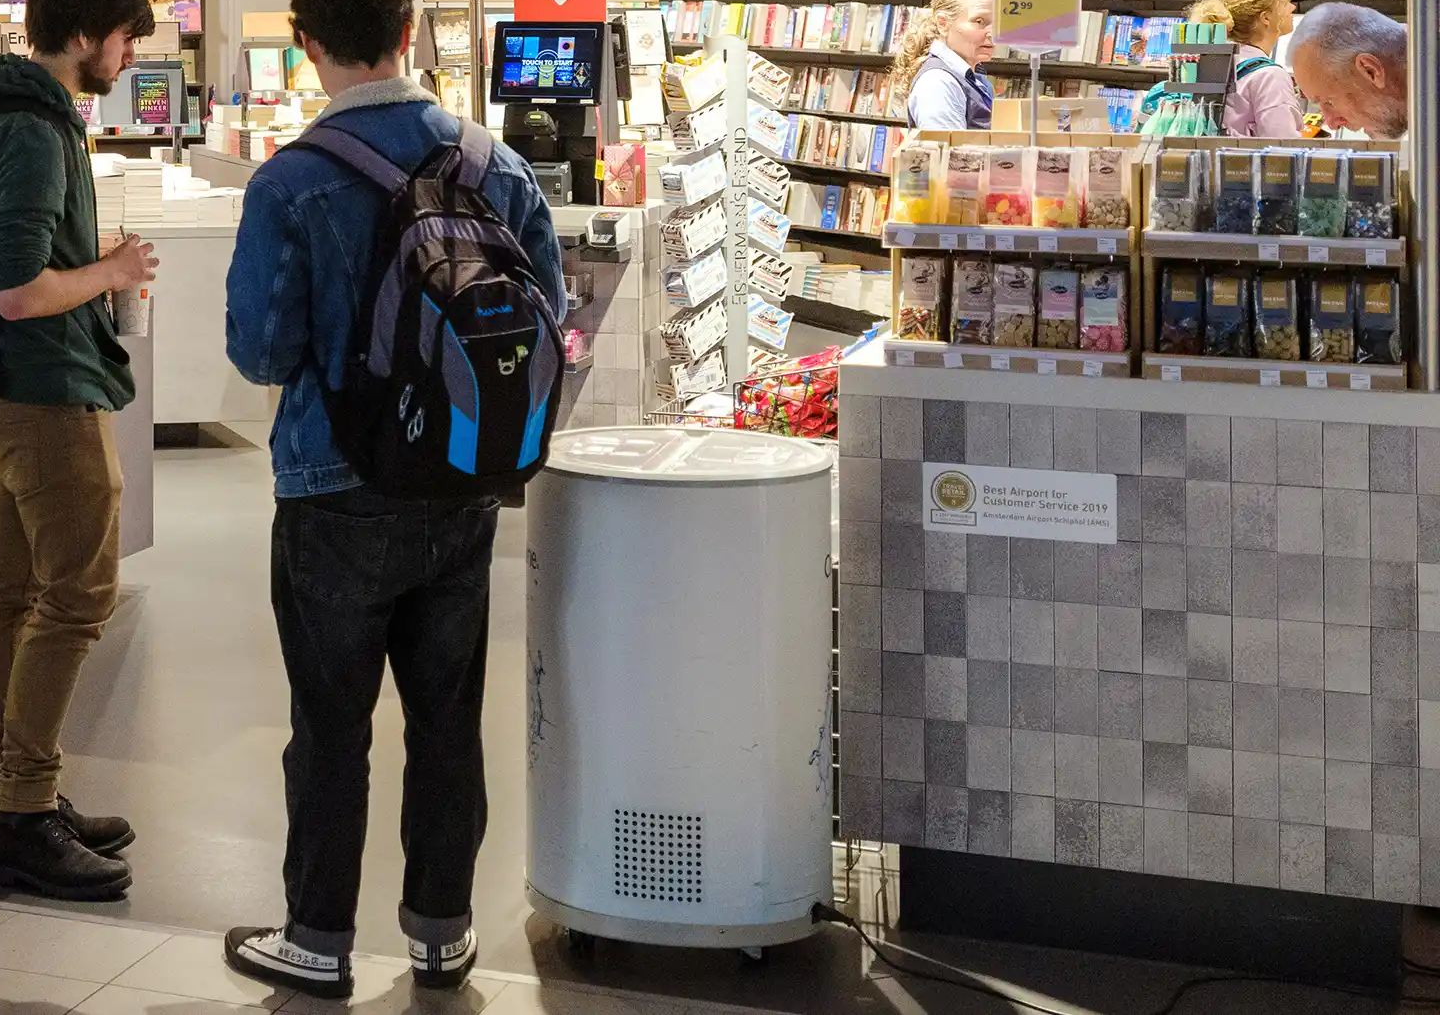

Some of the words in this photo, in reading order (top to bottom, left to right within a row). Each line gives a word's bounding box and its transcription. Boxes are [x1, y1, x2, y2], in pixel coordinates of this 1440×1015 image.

[983, 485, 1007, 495] Best
[1010, 487, 1049, 500] Airport
[1051, 489, 1068, 500] for
[983, 497, 1036, 510] Customer
[1039, 500, 1079, 512] Service
[1082, 502, 1108, 513] 2019
[983, 512, 1025, 522] Amsterdam
[1027, 514, 1052, 524] Airport
[1054, 516, 1086, 526] Schiphol
